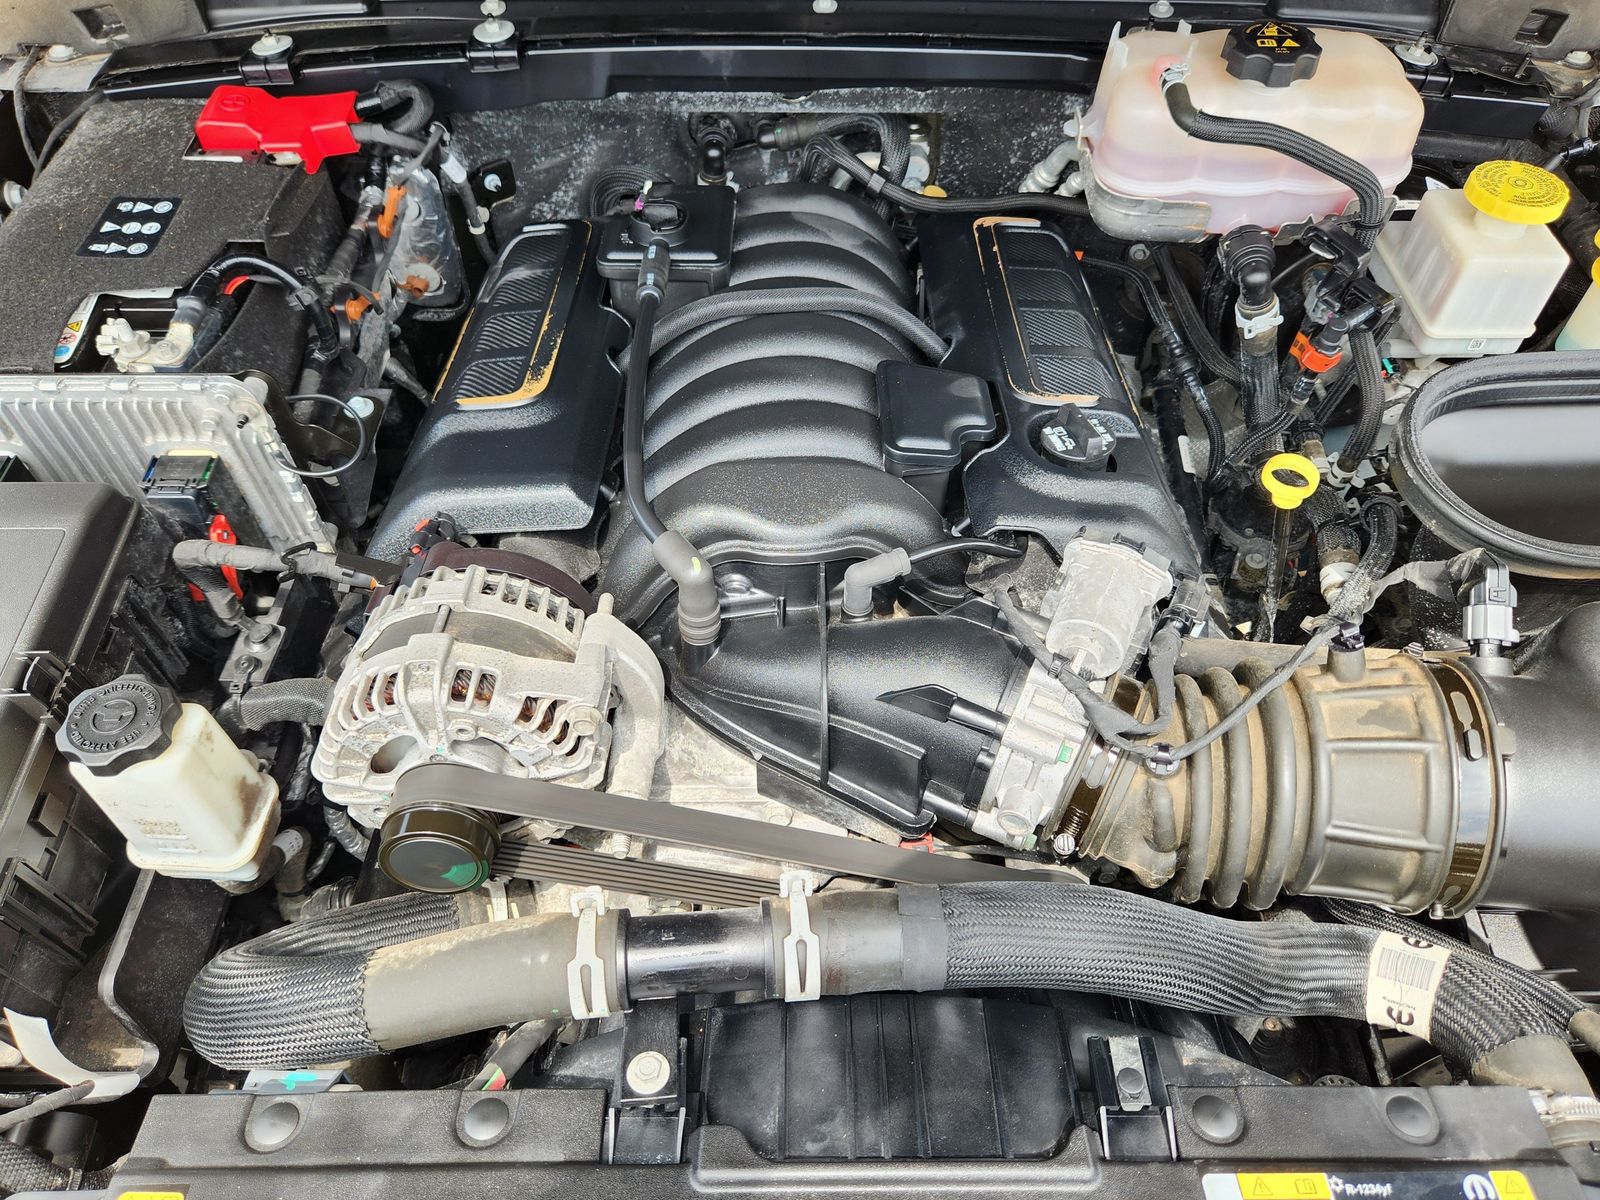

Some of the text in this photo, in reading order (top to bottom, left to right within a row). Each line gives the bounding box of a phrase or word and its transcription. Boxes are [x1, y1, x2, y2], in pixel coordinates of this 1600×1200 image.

[96, 683, 146, 697] STEERING
[73, 695, 97, 719] FLUID
[71, 729, 142, 751] USE APPROVED
[1345, 1183, 1392, 1197] R-1234yf
